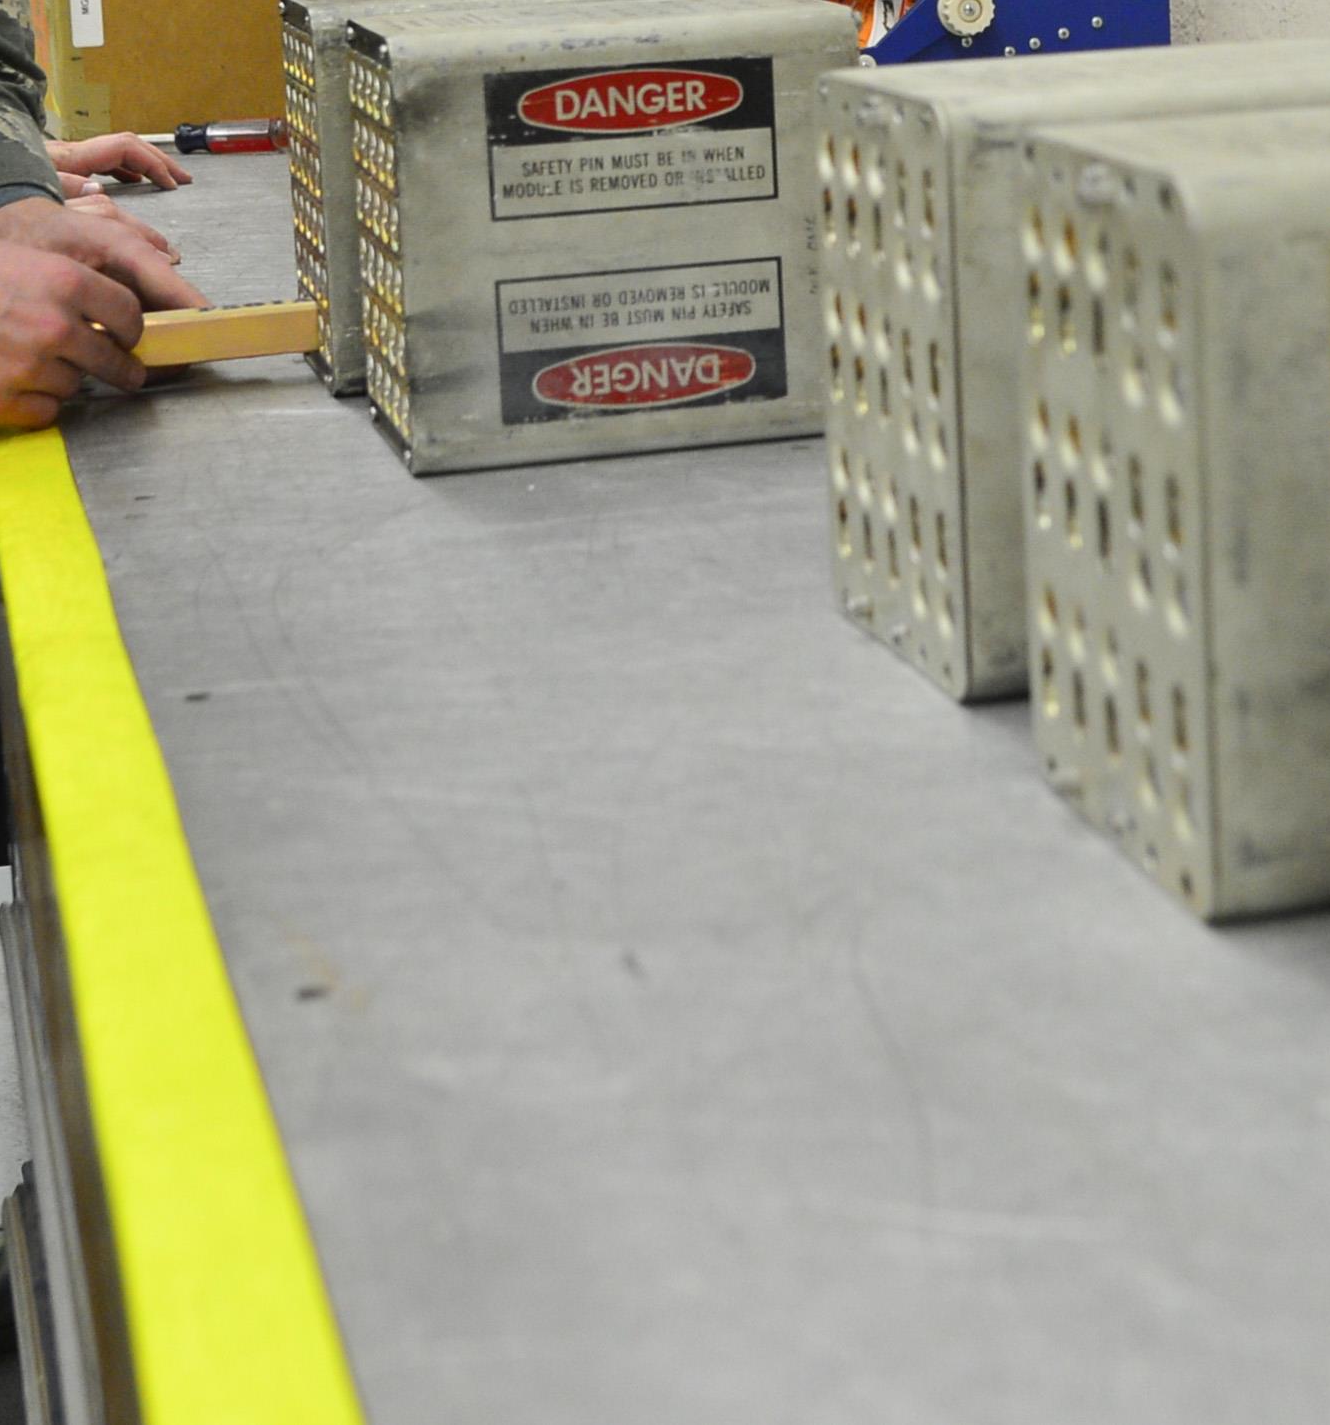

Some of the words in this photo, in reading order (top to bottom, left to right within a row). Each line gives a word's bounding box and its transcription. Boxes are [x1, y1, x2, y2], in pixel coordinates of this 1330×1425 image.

[555, 79, 707, 122] DANGER
[521, 158, 572, 177] SAFETY
[580, 156, 604, 172] PIN
[612, 152, 649, 169] MUST
[657, 150, 675, 166] BE
[703, 146, 745, 162] WHEN
[502, 179, 563, 200] MODULE
[570, 177, 585, 195] IS
[590, 172, 658, 193] REMOVED
[665, 170, 684, 186] OR
[688, 165, 766, 185] NSALLED
[619, 286, 686, 305] REMOVED
[691, 284, 705, 298] IS
[713, 278, 770, 297] MODULE
[508, 294, 586, 315] INSTALLED
[592, 291, 612, 308] OR
[702, 299, 752, 318] SAFETY
[579, 315, 594, 330] IN
[603, 312, 619, 328] BE
[626, 308, 665, 325] MUST
[671, 305, 696, 321] PIN
[530, 316, 572, 334] WHEN
[571, 354, 723, 397] DANGER
